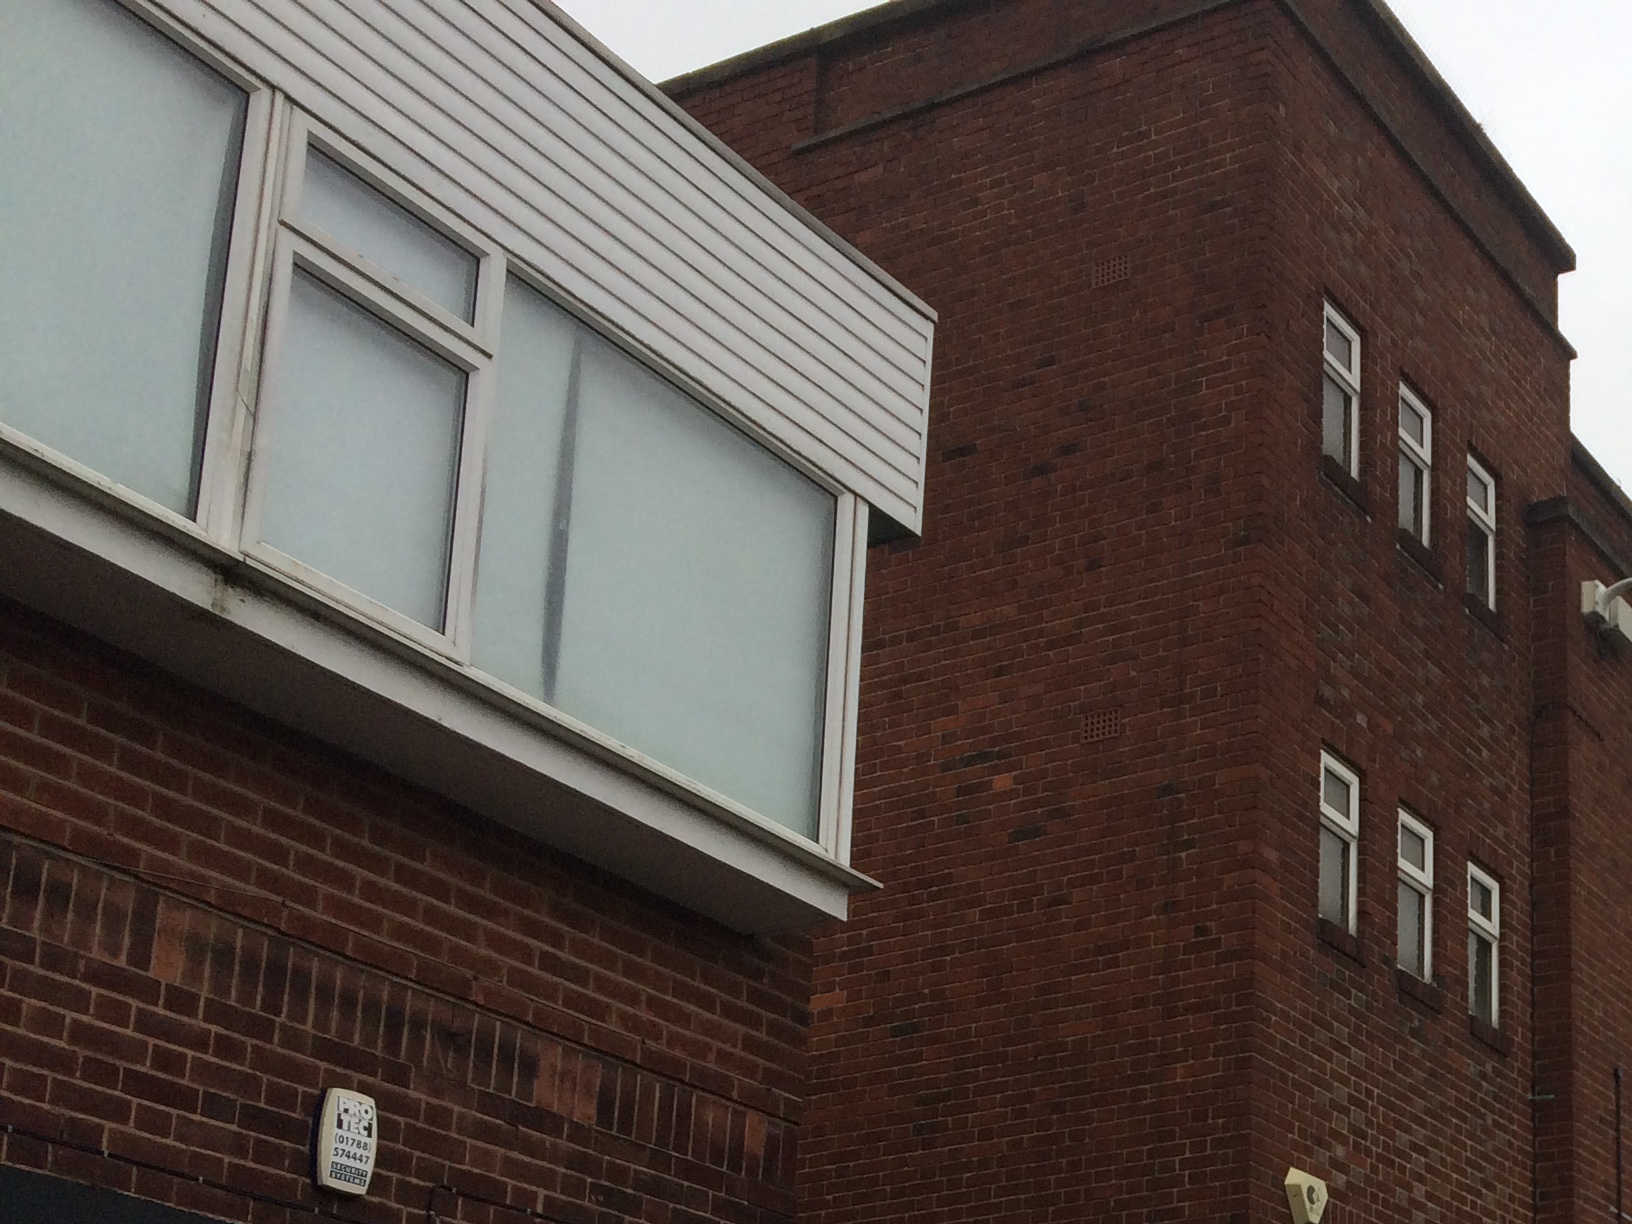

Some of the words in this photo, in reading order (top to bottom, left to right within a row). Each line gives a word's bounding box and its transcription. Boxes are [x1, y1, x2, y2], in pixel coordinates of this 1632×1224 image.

[339, 1097, 373, 1120] PRO
[340, 1114, 370, 1136] TEC
[335, 1132, 372, 1153] (01788)
[332, 1146, 370, 1165] 574447
